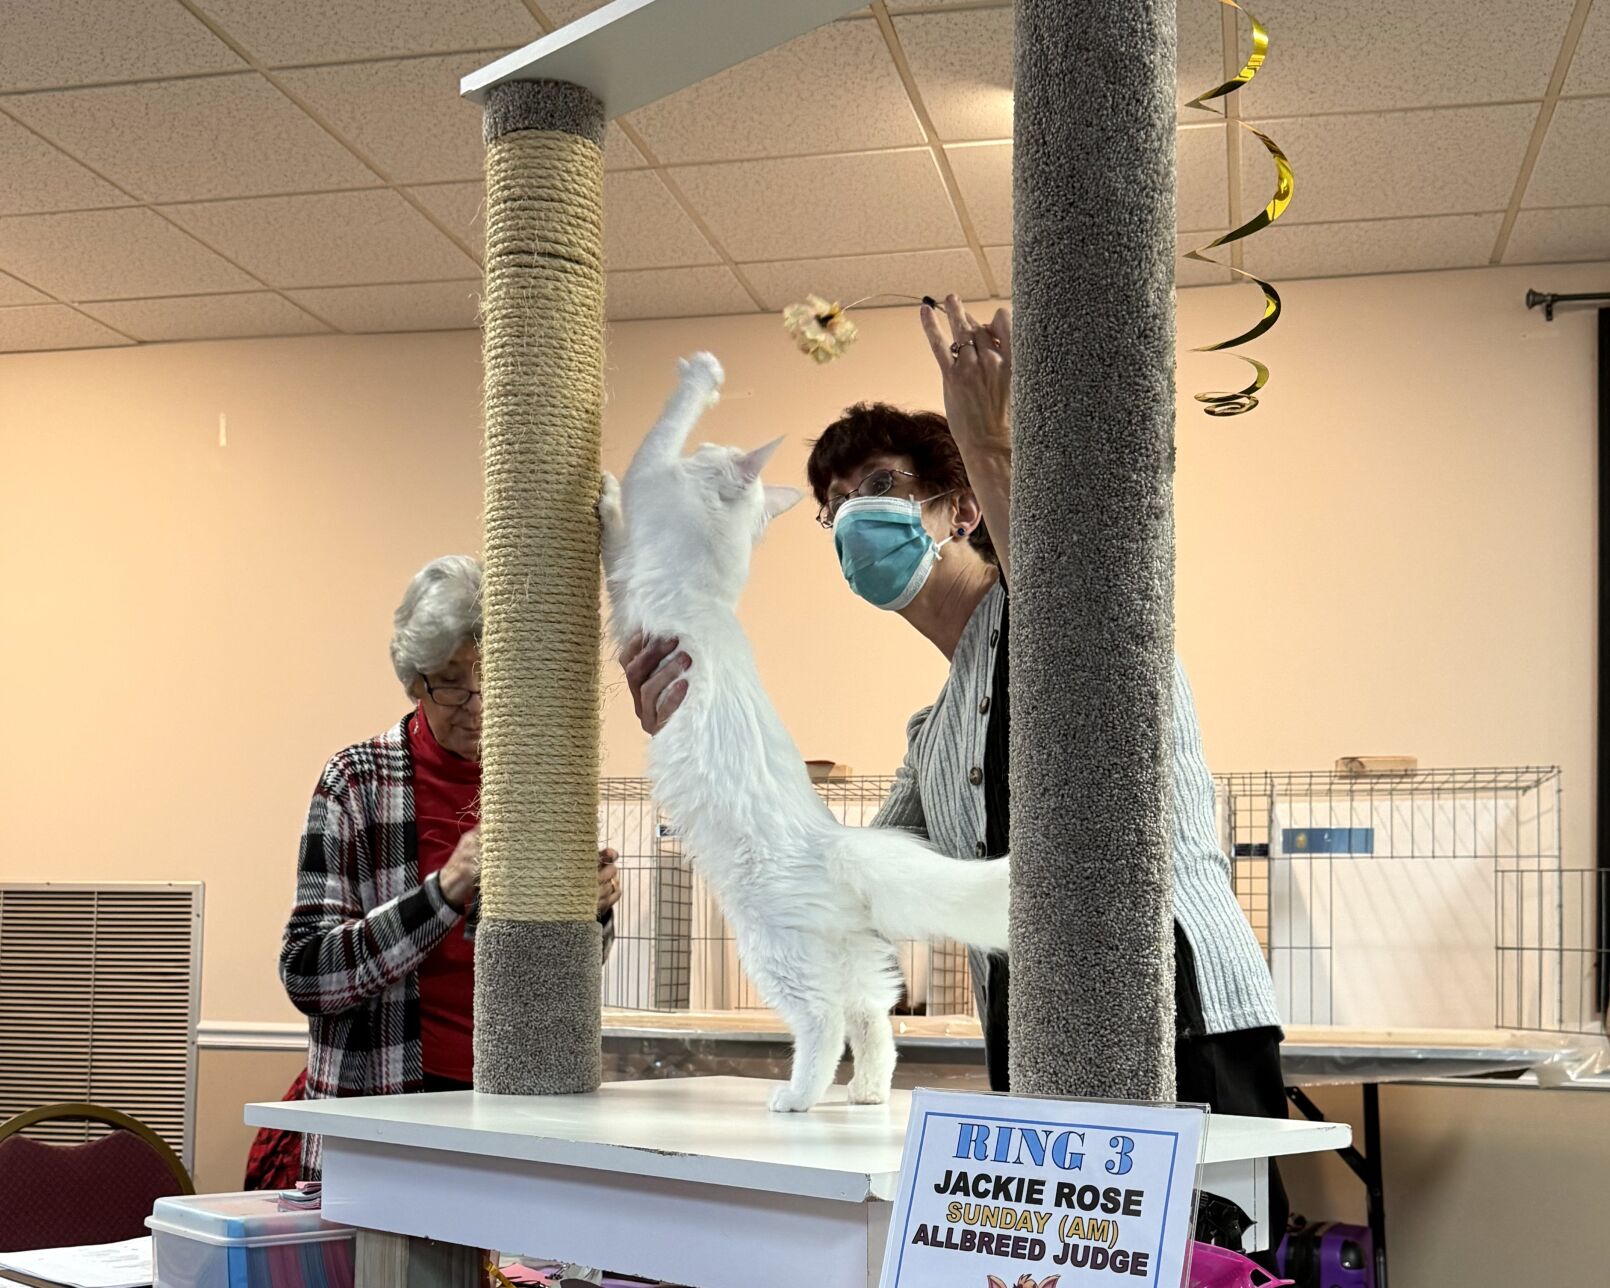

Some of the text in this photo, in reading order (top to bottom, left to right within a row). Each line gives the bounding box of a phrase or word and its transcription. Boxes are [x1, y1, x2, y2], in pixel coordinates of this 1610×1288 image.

[953, 1123, 1135, 1175] RING 3
[934, 1170, 1144, 1216] JACKIE ROSE
[946, 1202, 1119, 1248] SUNDAY (AM)
[912, 1224, 1149, 1276] ALLBREED JUDGE
